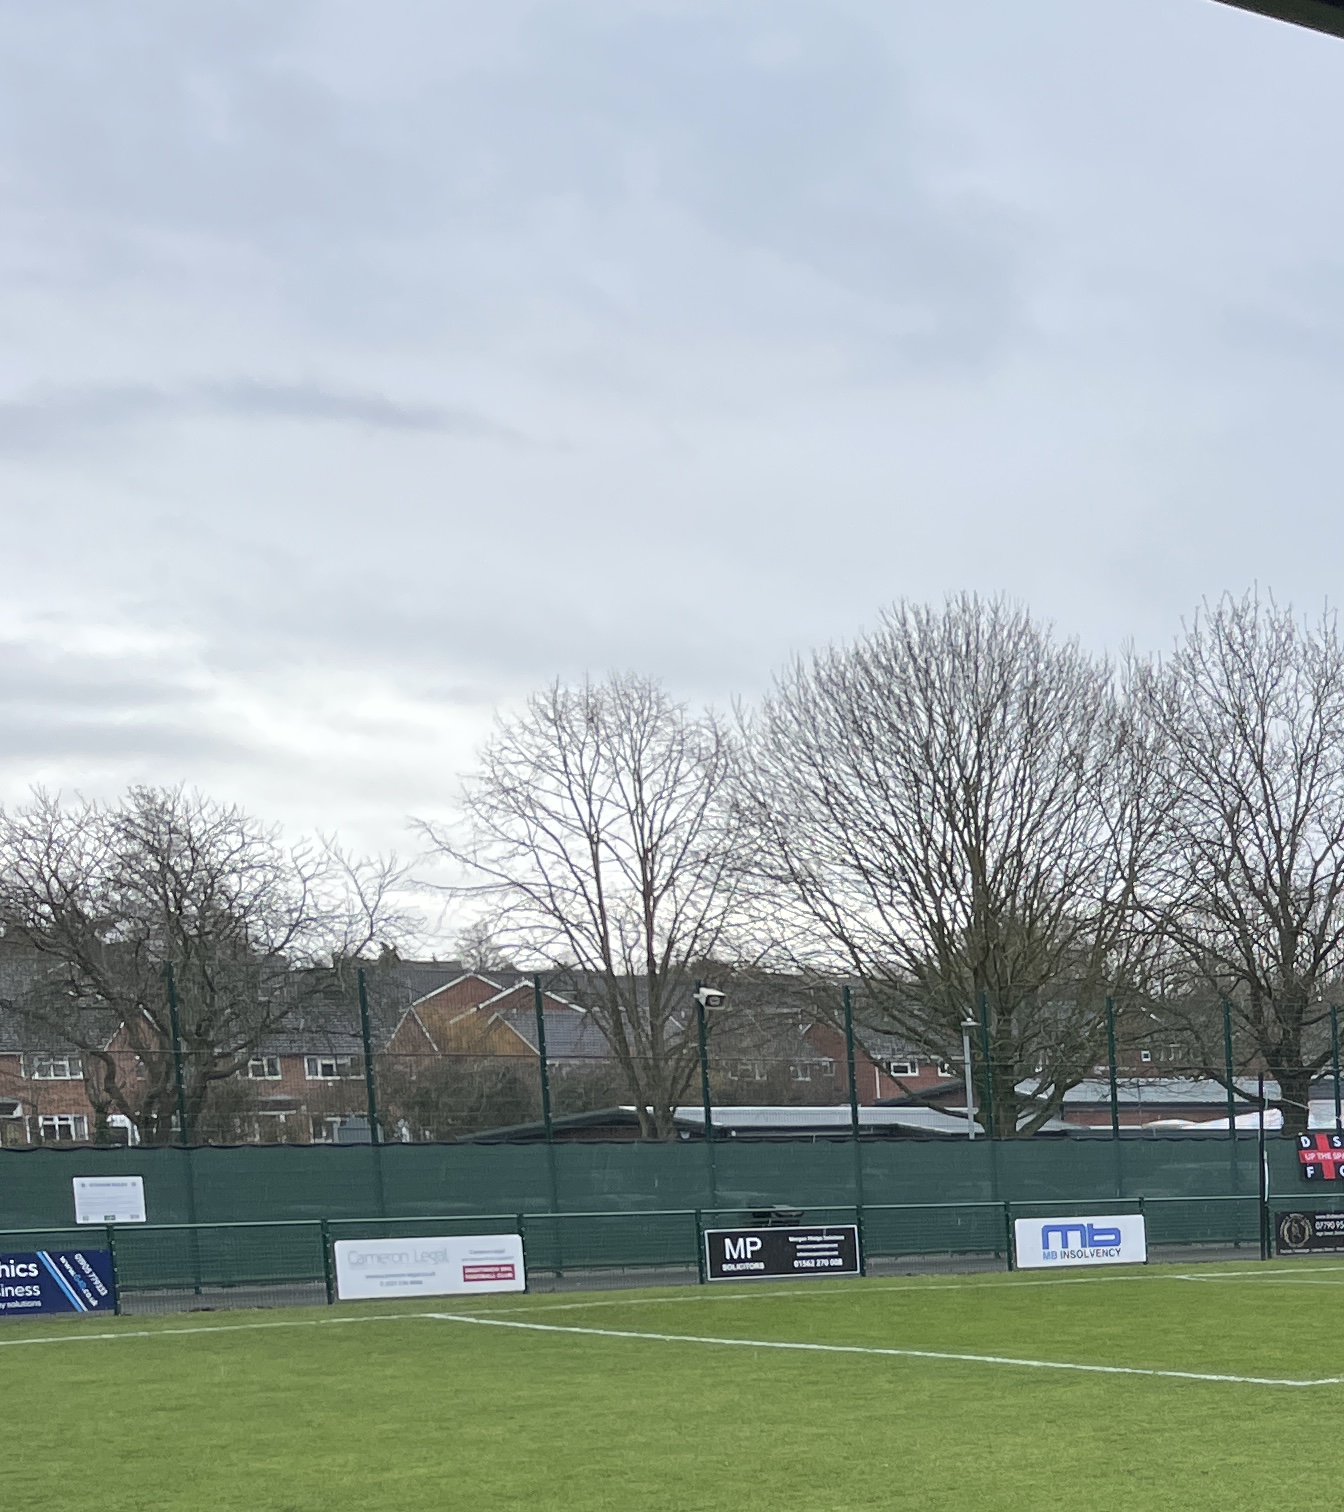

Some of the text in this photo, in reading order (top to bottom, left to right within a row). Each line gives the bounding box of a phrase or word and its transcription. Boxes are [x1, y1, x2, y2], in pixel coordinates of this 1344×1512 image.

[1301, 1136, 1311, 1147] D
[1333, 1136, 1341, 1147] S
[1317, 1152, 1332, 1160] THE
[1307, 1166, 1314, 1178] F
[724, 1237, 762, 1260] MP
[1043, 1248, 1121, 1261] MB INSOLVENCY
[347, 1247, 449, 1266] Cameron Legal
[722, 1262, 765, 1272] SOLICITORS
[0, 1284, 41, 1297] iness
